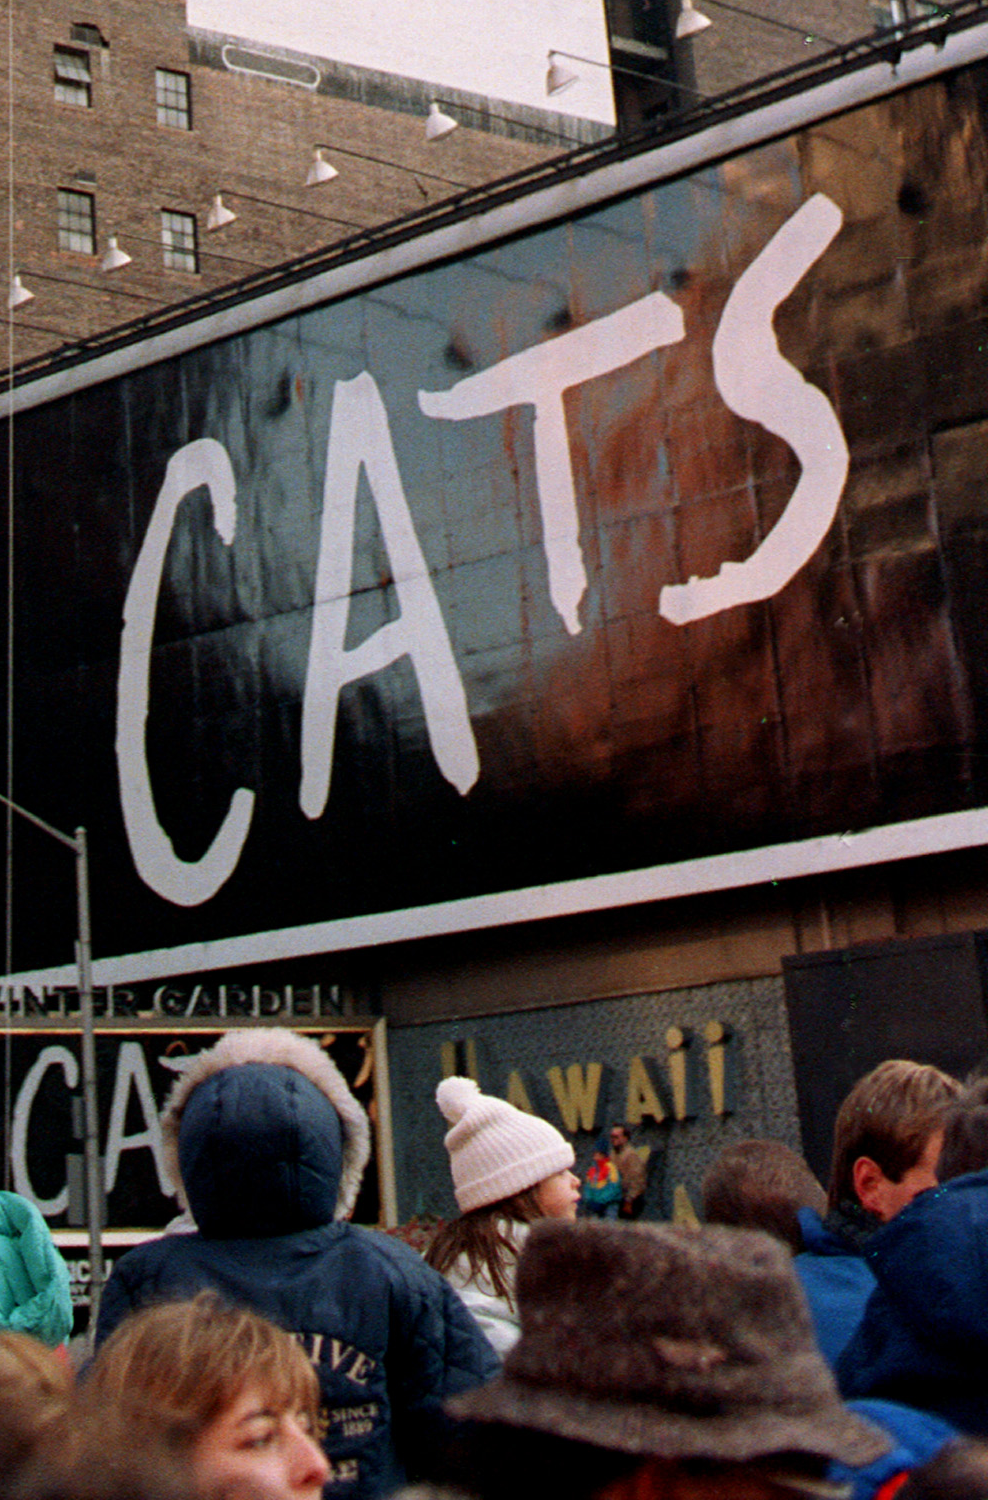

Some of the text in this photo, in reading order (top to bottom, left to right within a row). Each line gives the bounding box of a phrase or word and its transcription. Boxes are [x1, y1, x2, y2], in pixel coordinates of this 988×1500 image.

[116, 192, 850, 906] CATS
[153, 985, 340, 1017] GARDEN
[331, 1402, 379, 1423] SINCE
